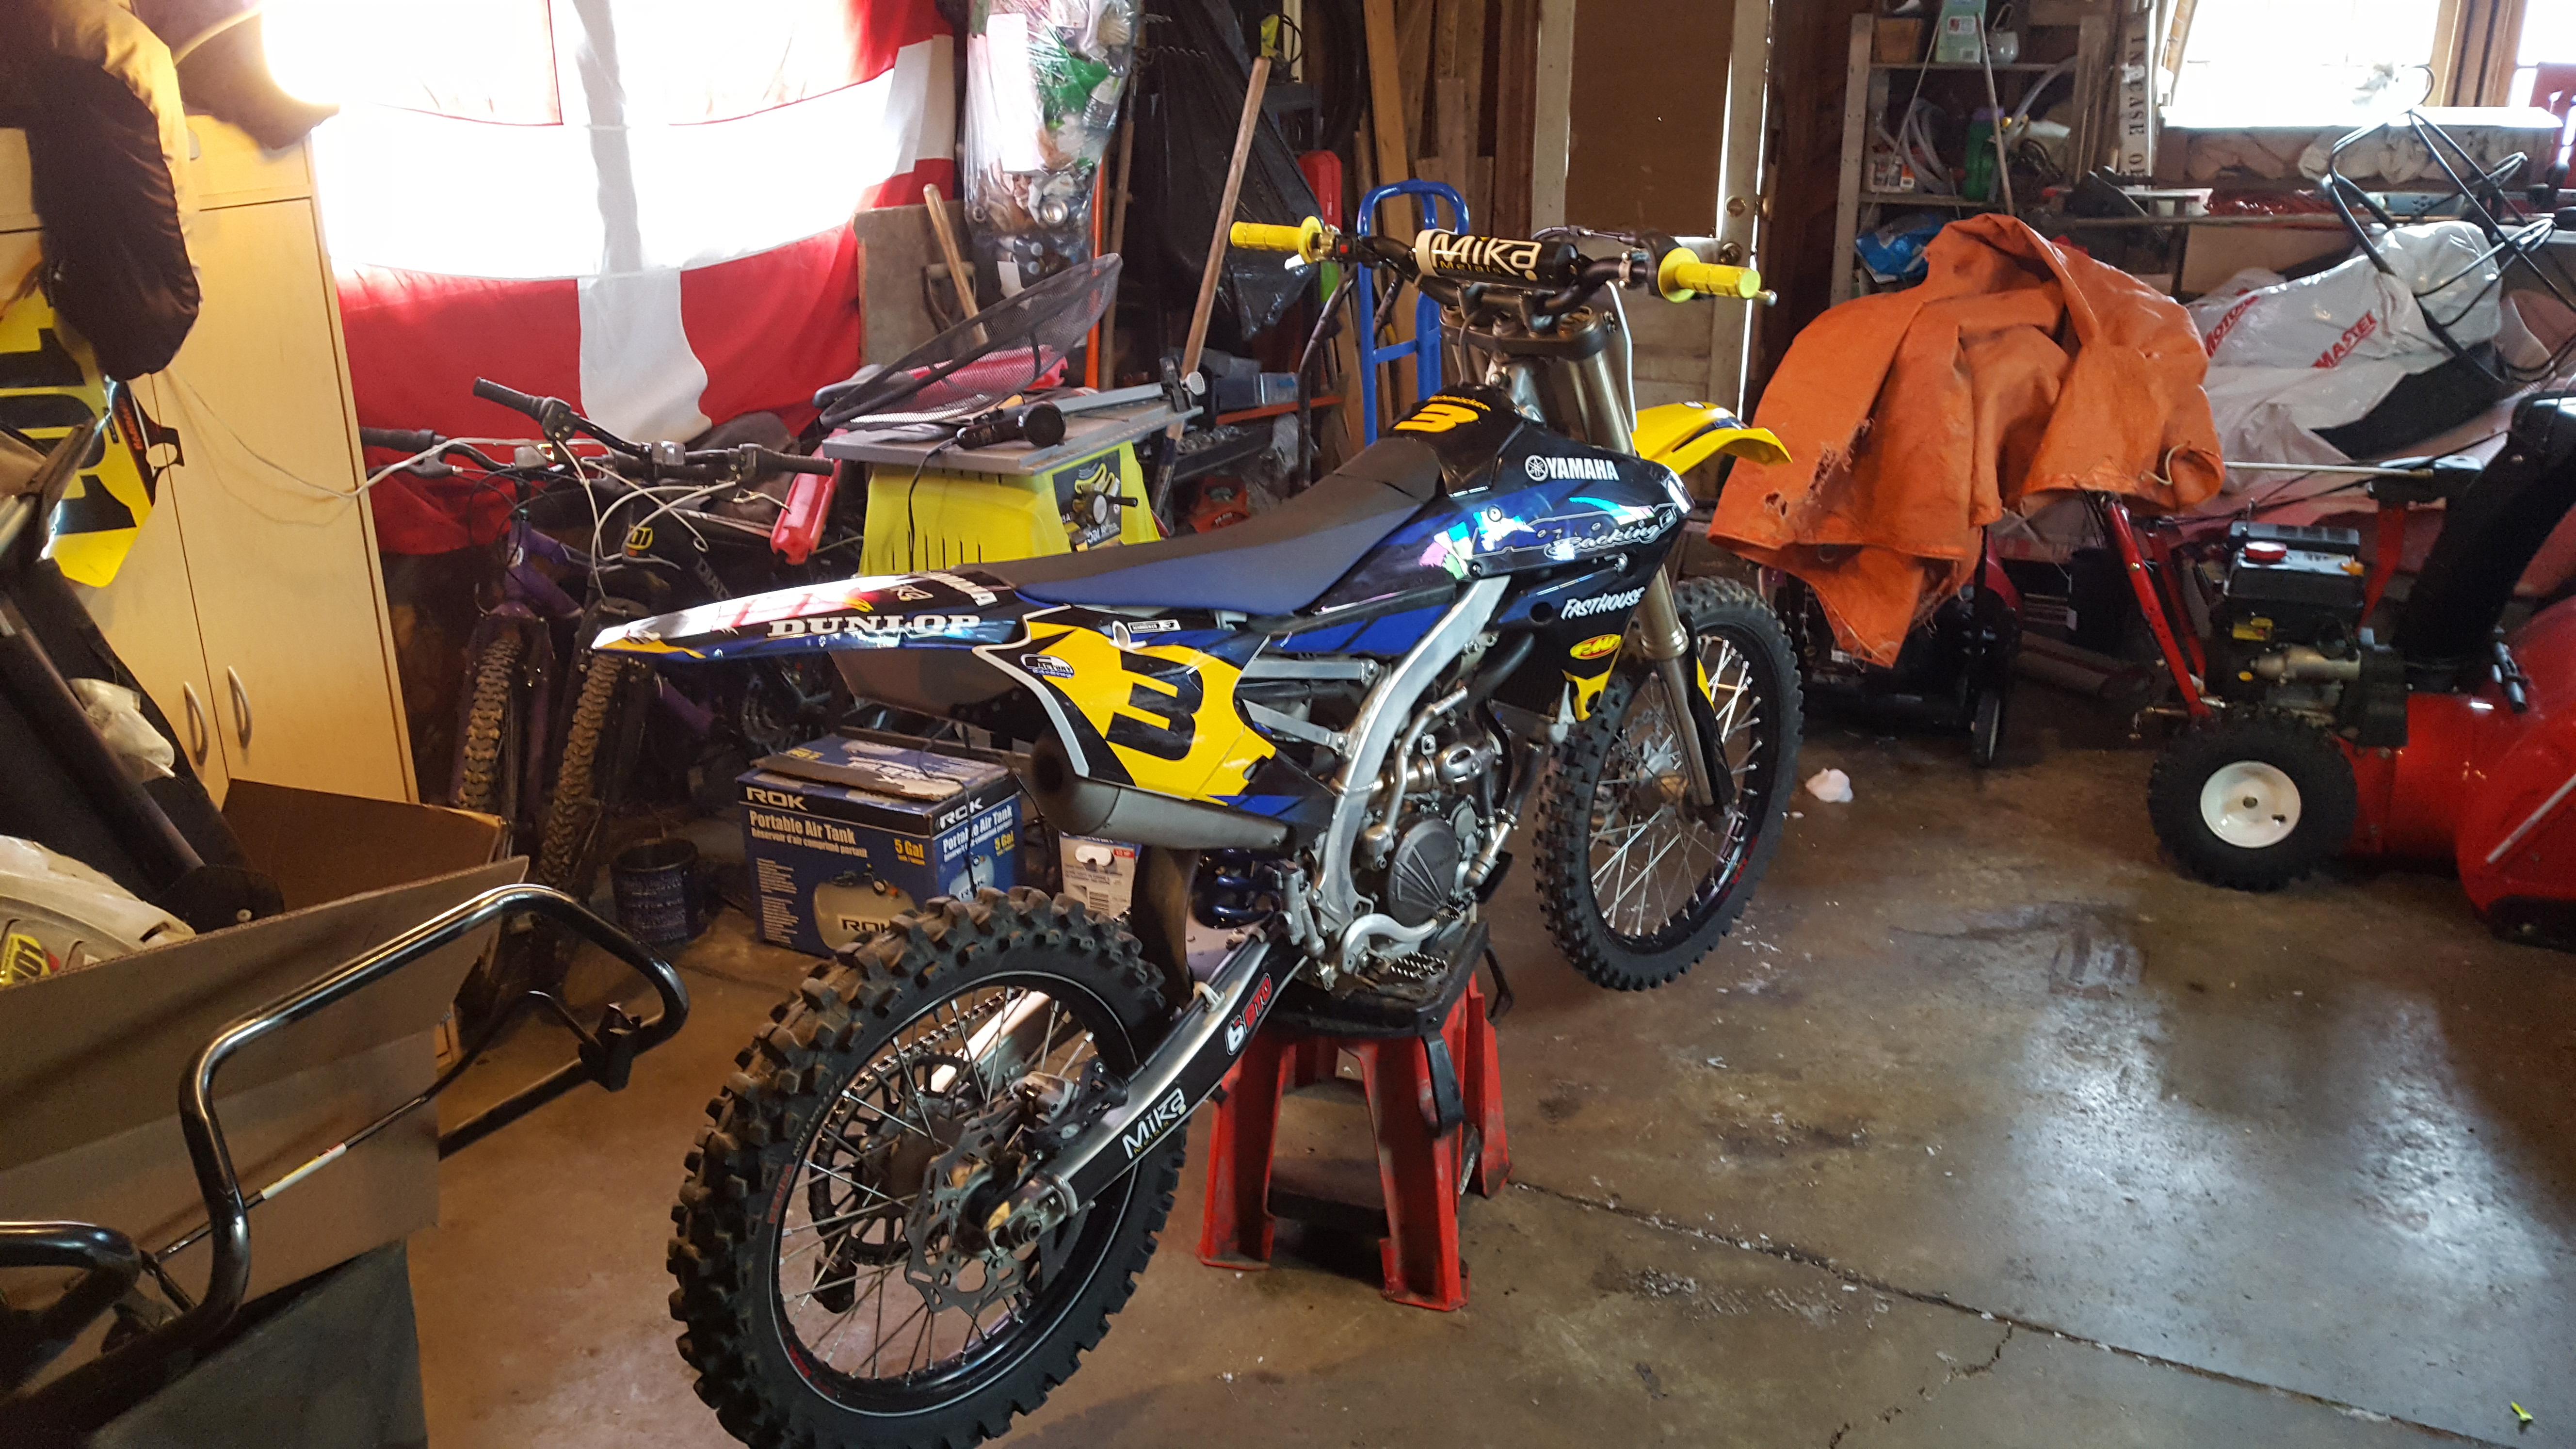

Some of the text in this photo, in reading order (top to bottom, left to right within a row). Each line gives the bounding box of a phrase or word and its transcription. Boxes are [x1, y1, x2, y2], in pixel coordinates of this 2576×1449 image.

[1394, 403, 1479, 433] 3
[1546, 457, 1620, 481] YAMAHA
[1560, 586, 1645, 620] FASTHOUSE
[767, 614, 981, 638] DUNLOP
[1105, 649, 1204, 761] 3
[745, 786, 808, 811] ROK
[939, 797, 984, 829] ROK
[749, 809, 856, 845] Portable Air Tank
[942, 823, 979, 853] Portale
[980, 816, 992, 834] Air
[992, 805, 1013, 825] Tank
[894, 838, 925, 859] 5 Gal
